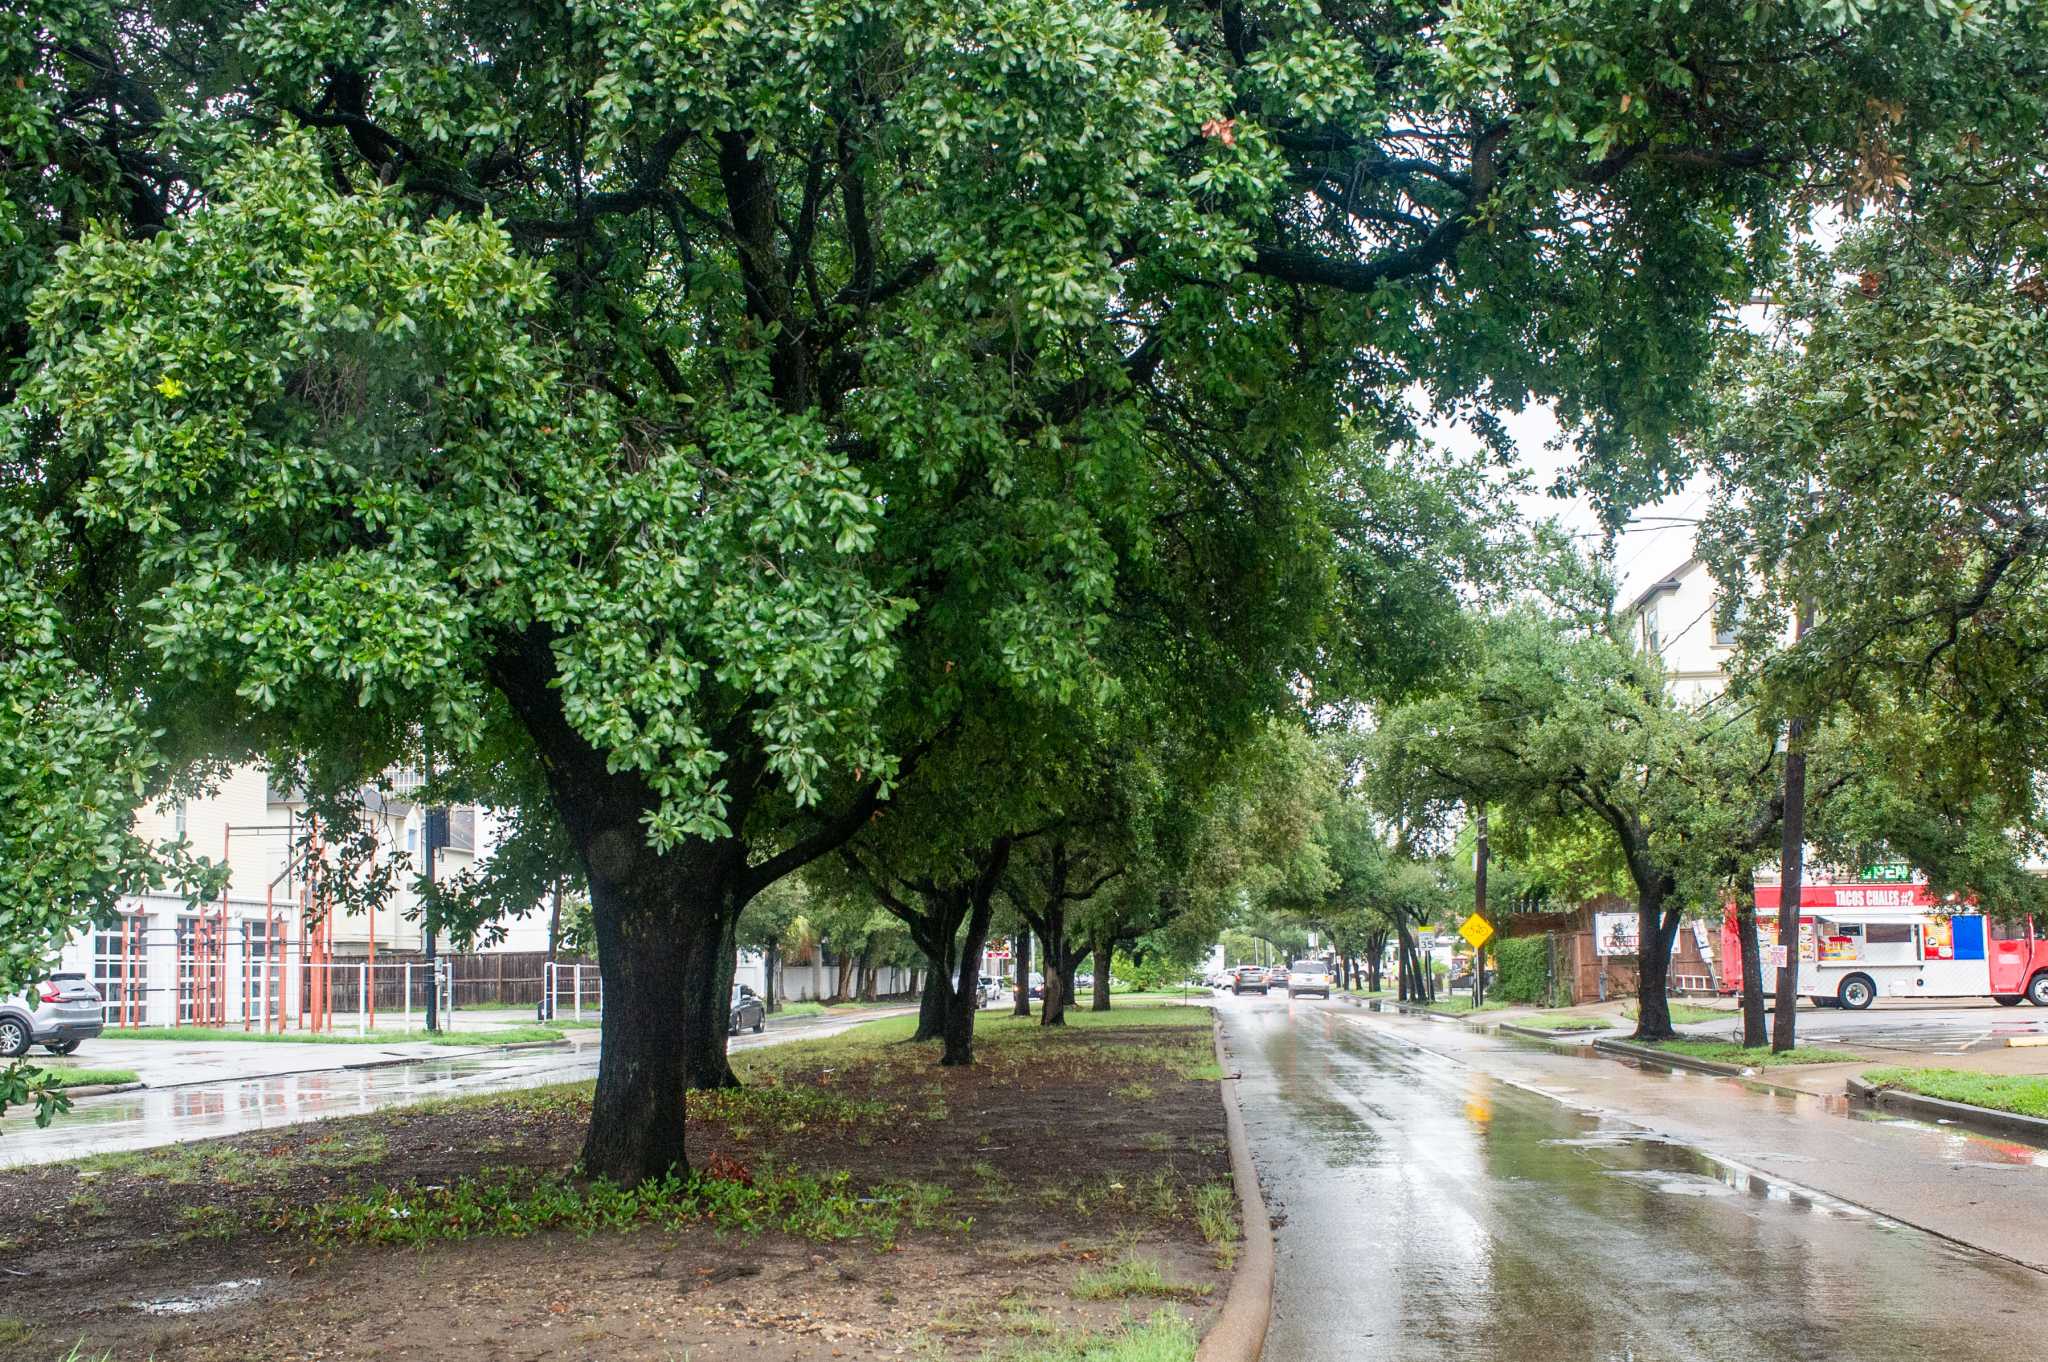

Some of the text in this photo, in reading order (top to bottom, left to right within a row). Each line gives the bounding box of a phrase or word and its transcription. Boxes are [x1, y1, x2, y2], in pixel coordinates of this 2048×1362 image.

[1835, 890, 1914, 906] TACOS CHALES #2
